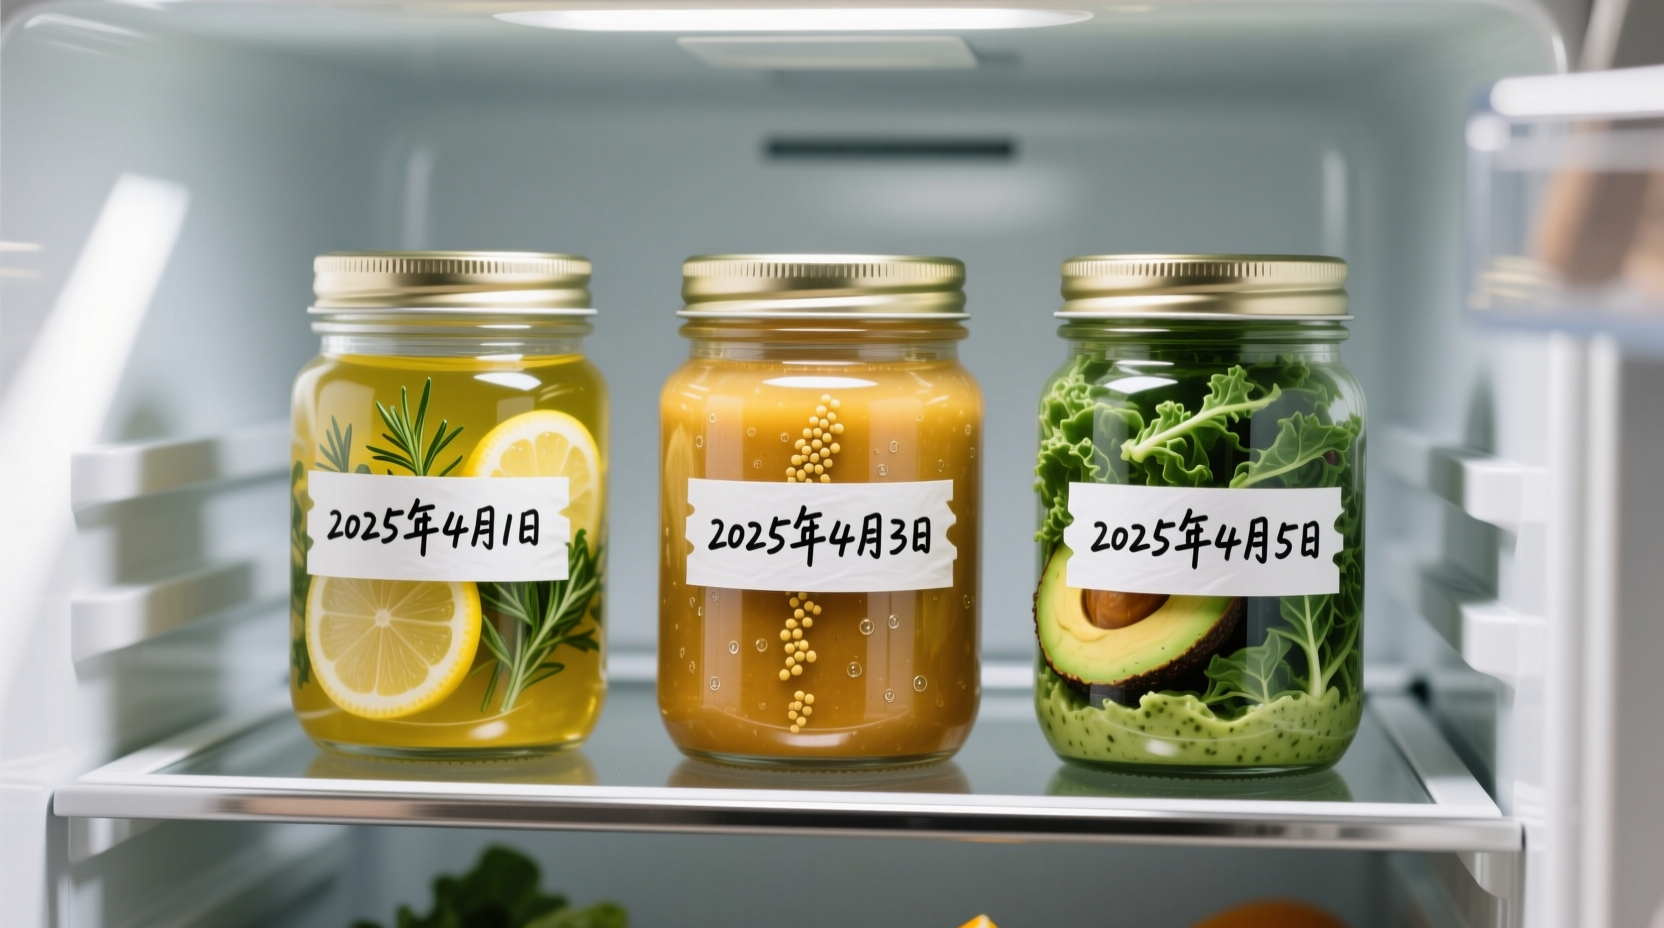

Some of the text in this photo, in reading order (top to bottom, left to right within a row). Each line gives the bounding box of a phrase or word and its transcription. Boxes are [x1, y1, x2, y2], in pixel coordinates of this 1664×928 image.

[326, 497, 540, 557] 2025年4月1日
[708, 504, 931, 568] 2025年4月3日
[1090, 507, 1320, 570] 2025年4月5日
